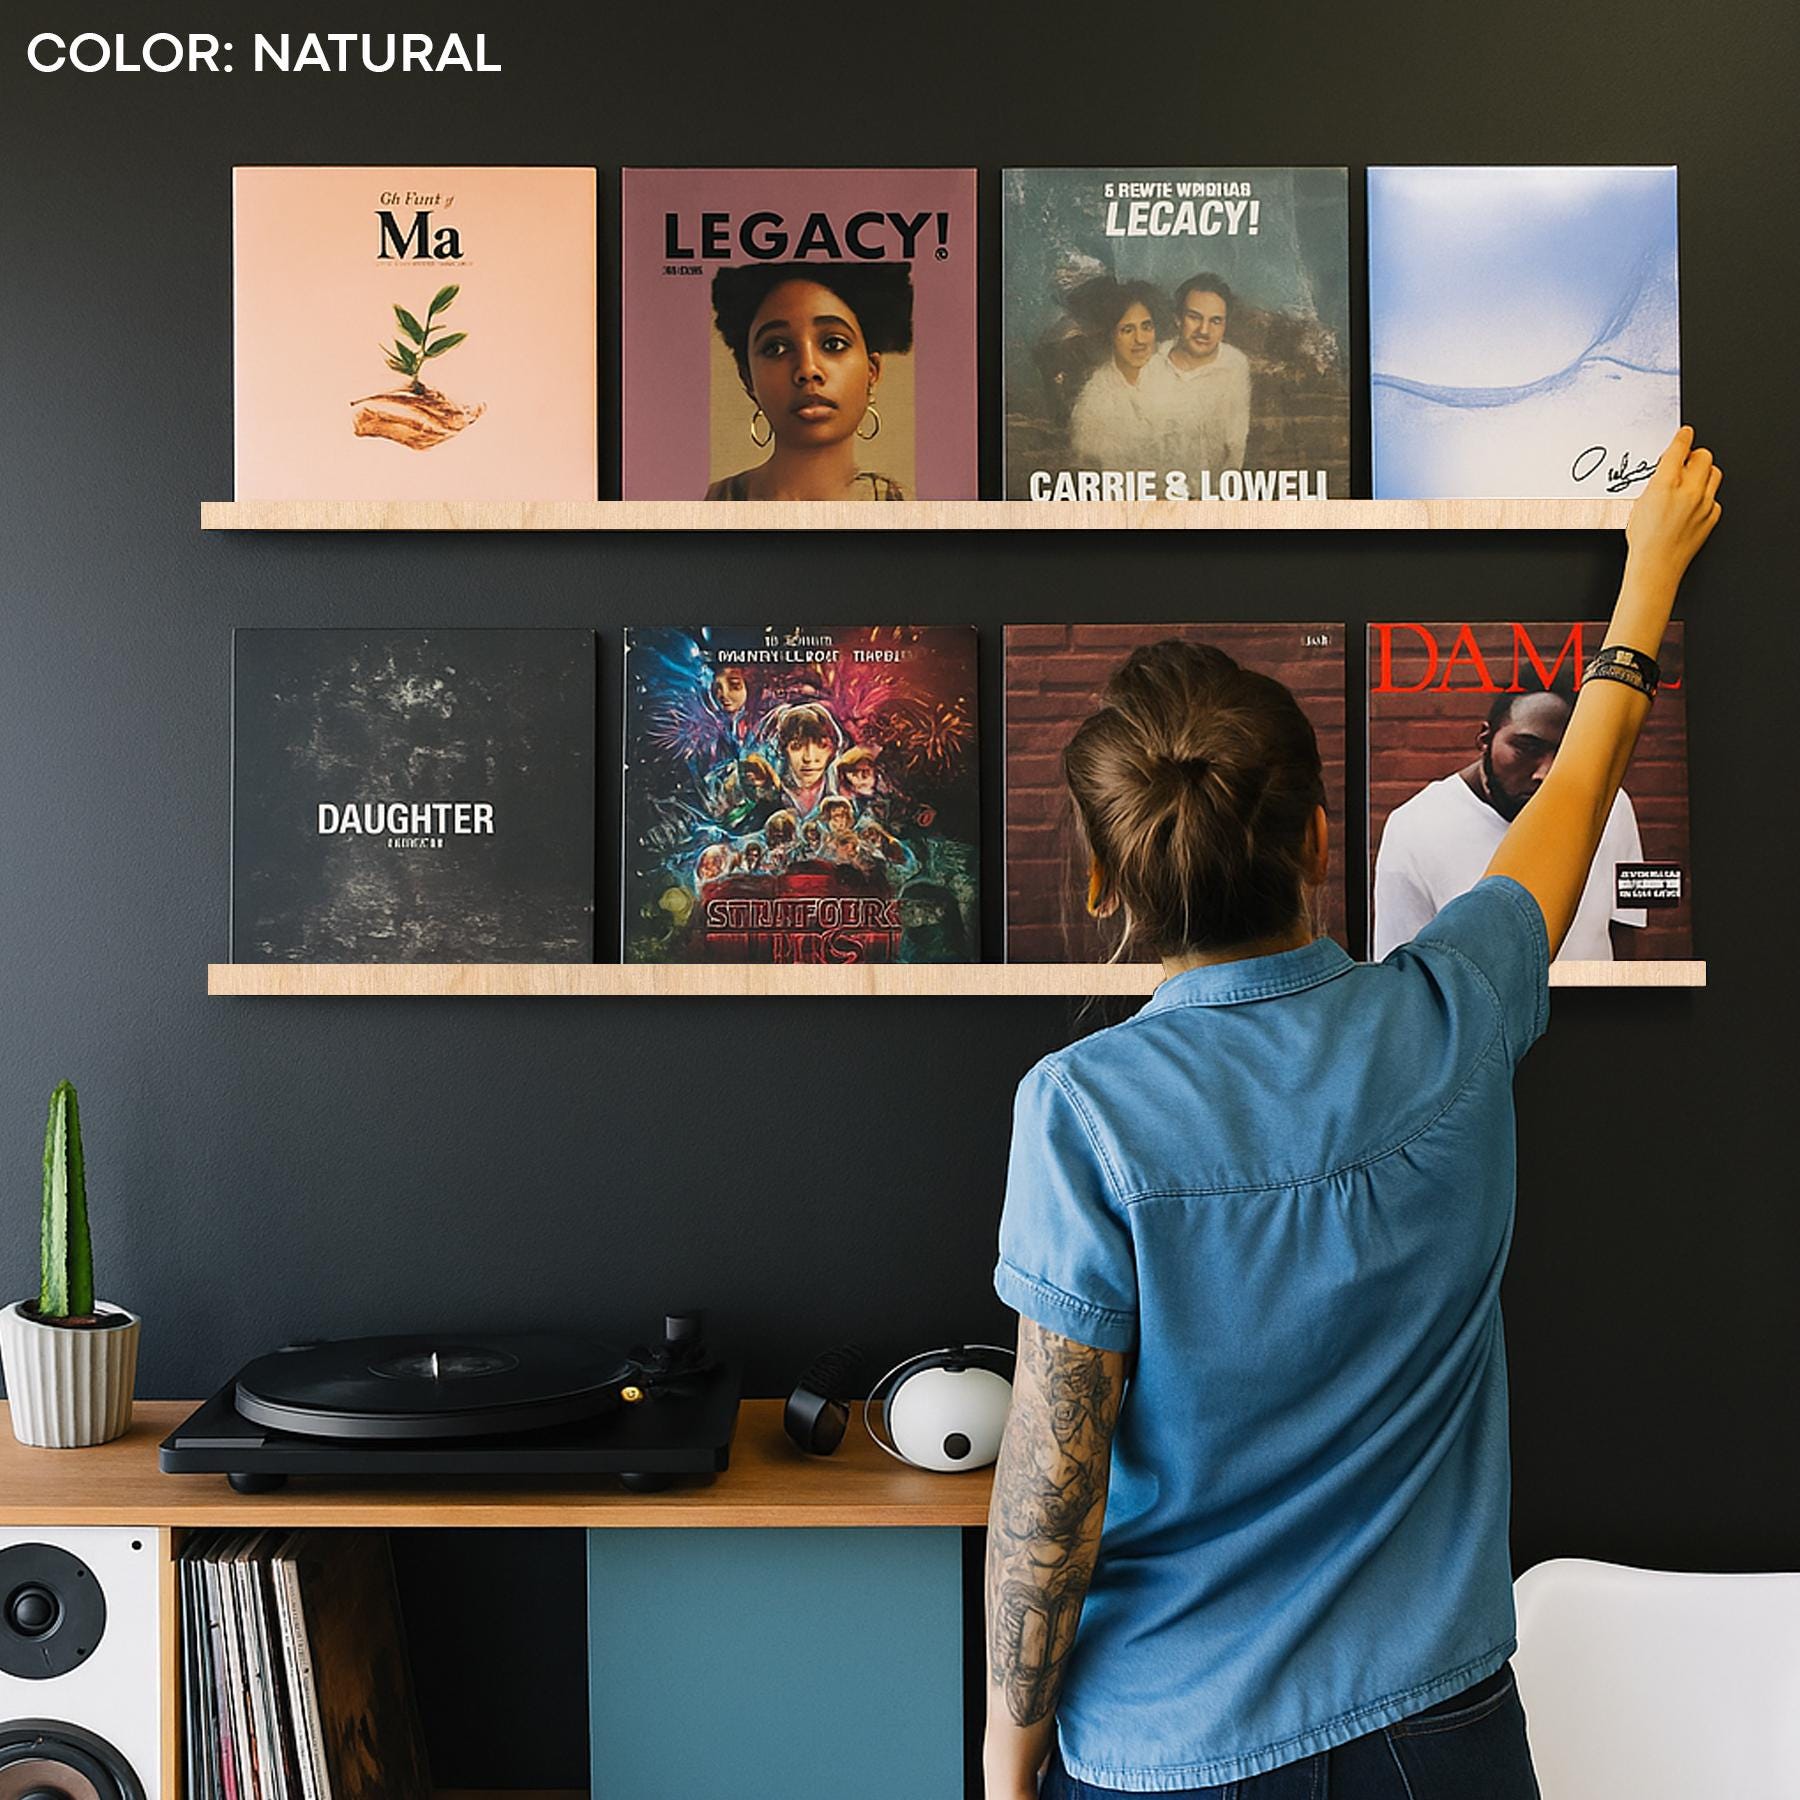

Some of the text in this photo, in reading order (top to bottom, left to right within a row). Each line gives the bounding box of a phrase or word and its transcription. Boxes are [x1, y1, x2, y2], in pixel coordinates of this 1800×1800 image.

[374, 210, 464, 260] Ma
[665, 211, 949, 261] LEGACY!
[1029, 470, 1157, 501] CARRIE
[1164, 470, 1191, 501] &
[318, 803, 494, 835] DAUGHTER
